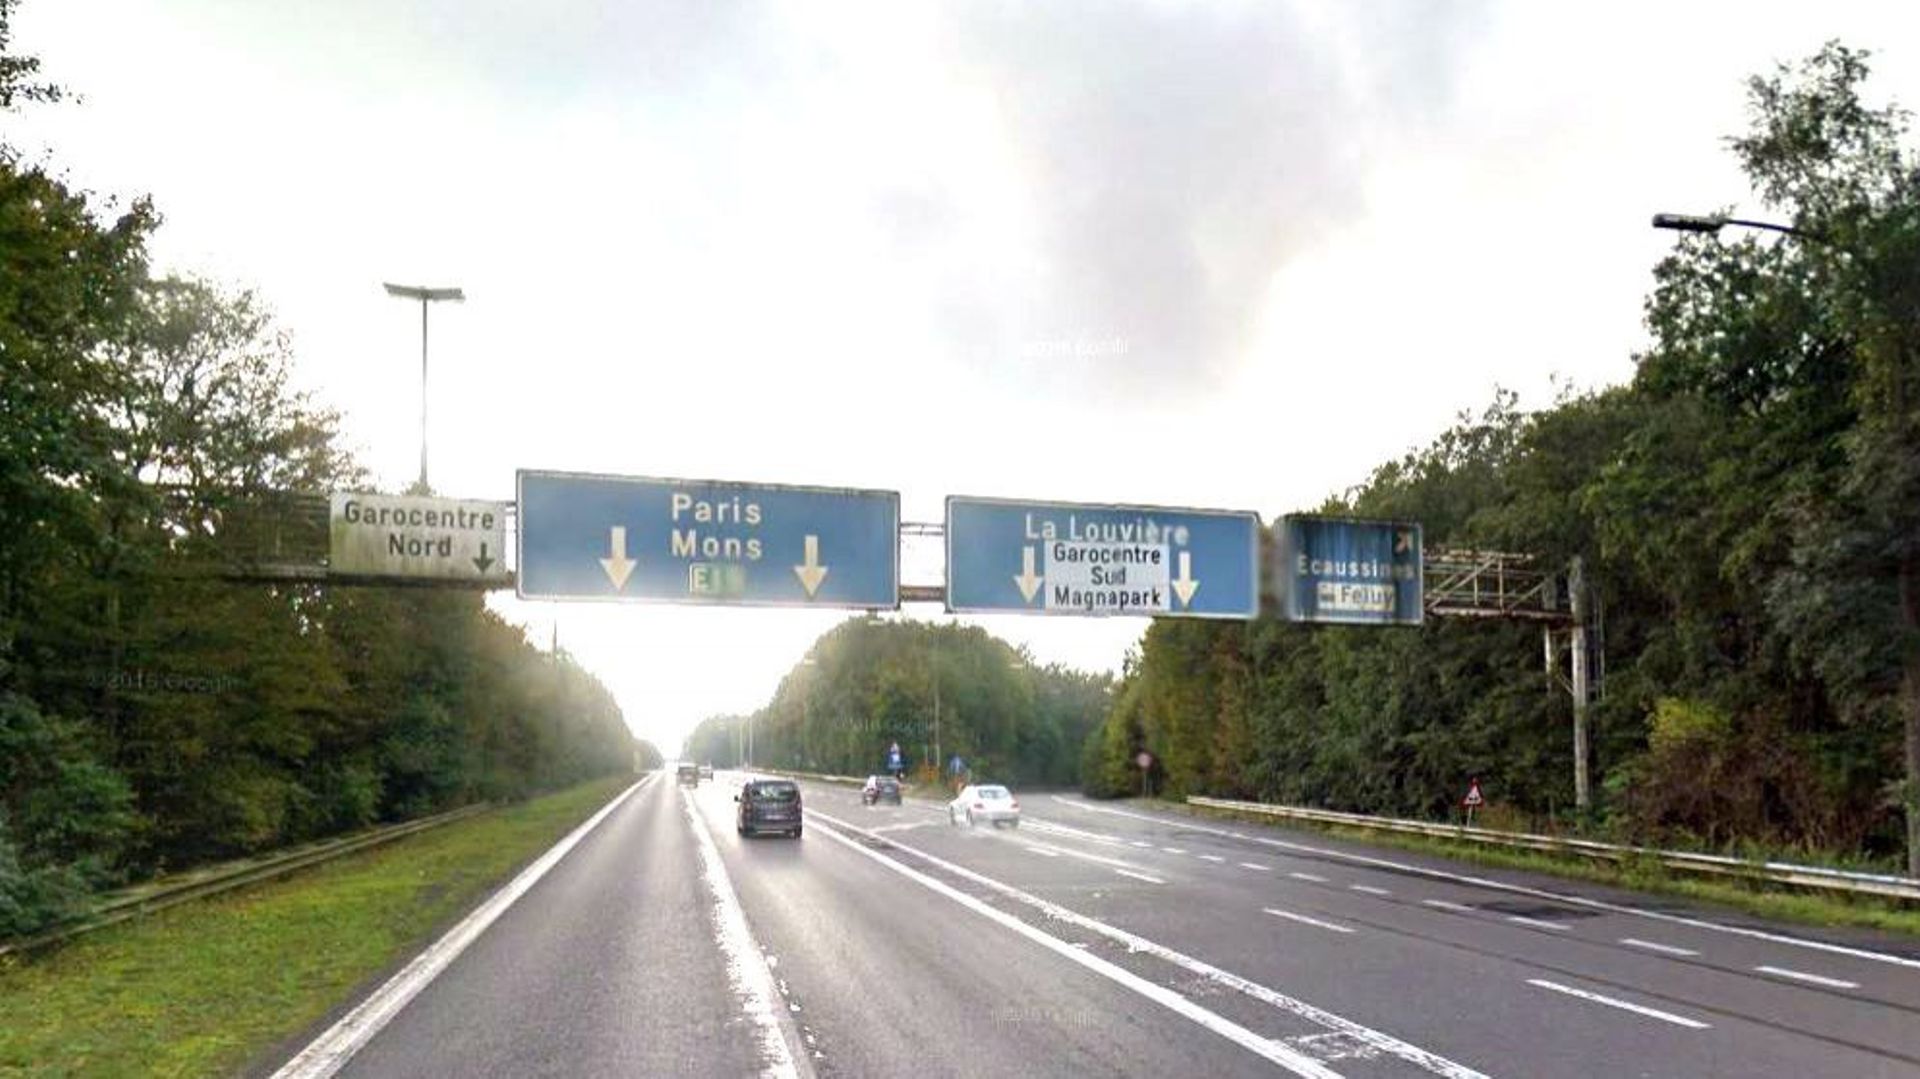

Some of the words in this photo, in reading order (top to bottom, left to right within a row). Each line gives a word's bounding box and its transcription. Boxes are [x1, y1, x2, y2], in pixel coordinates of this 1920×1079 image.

[345, 501, 494, 530] Garocentre
[672, 493, 761, 524] Paris
[1025, 513, 1056, 541] La
[1070, 514, 1190, 546] Louvière
[389, 534, 452, 557] Nord
[671, 529, 761, 559] Mons
[1054, 542, 1161, 565] Garocentre
[1091, 566, 1127, 586] Sud
[1054, 586, 1162, 611] Magnapark
